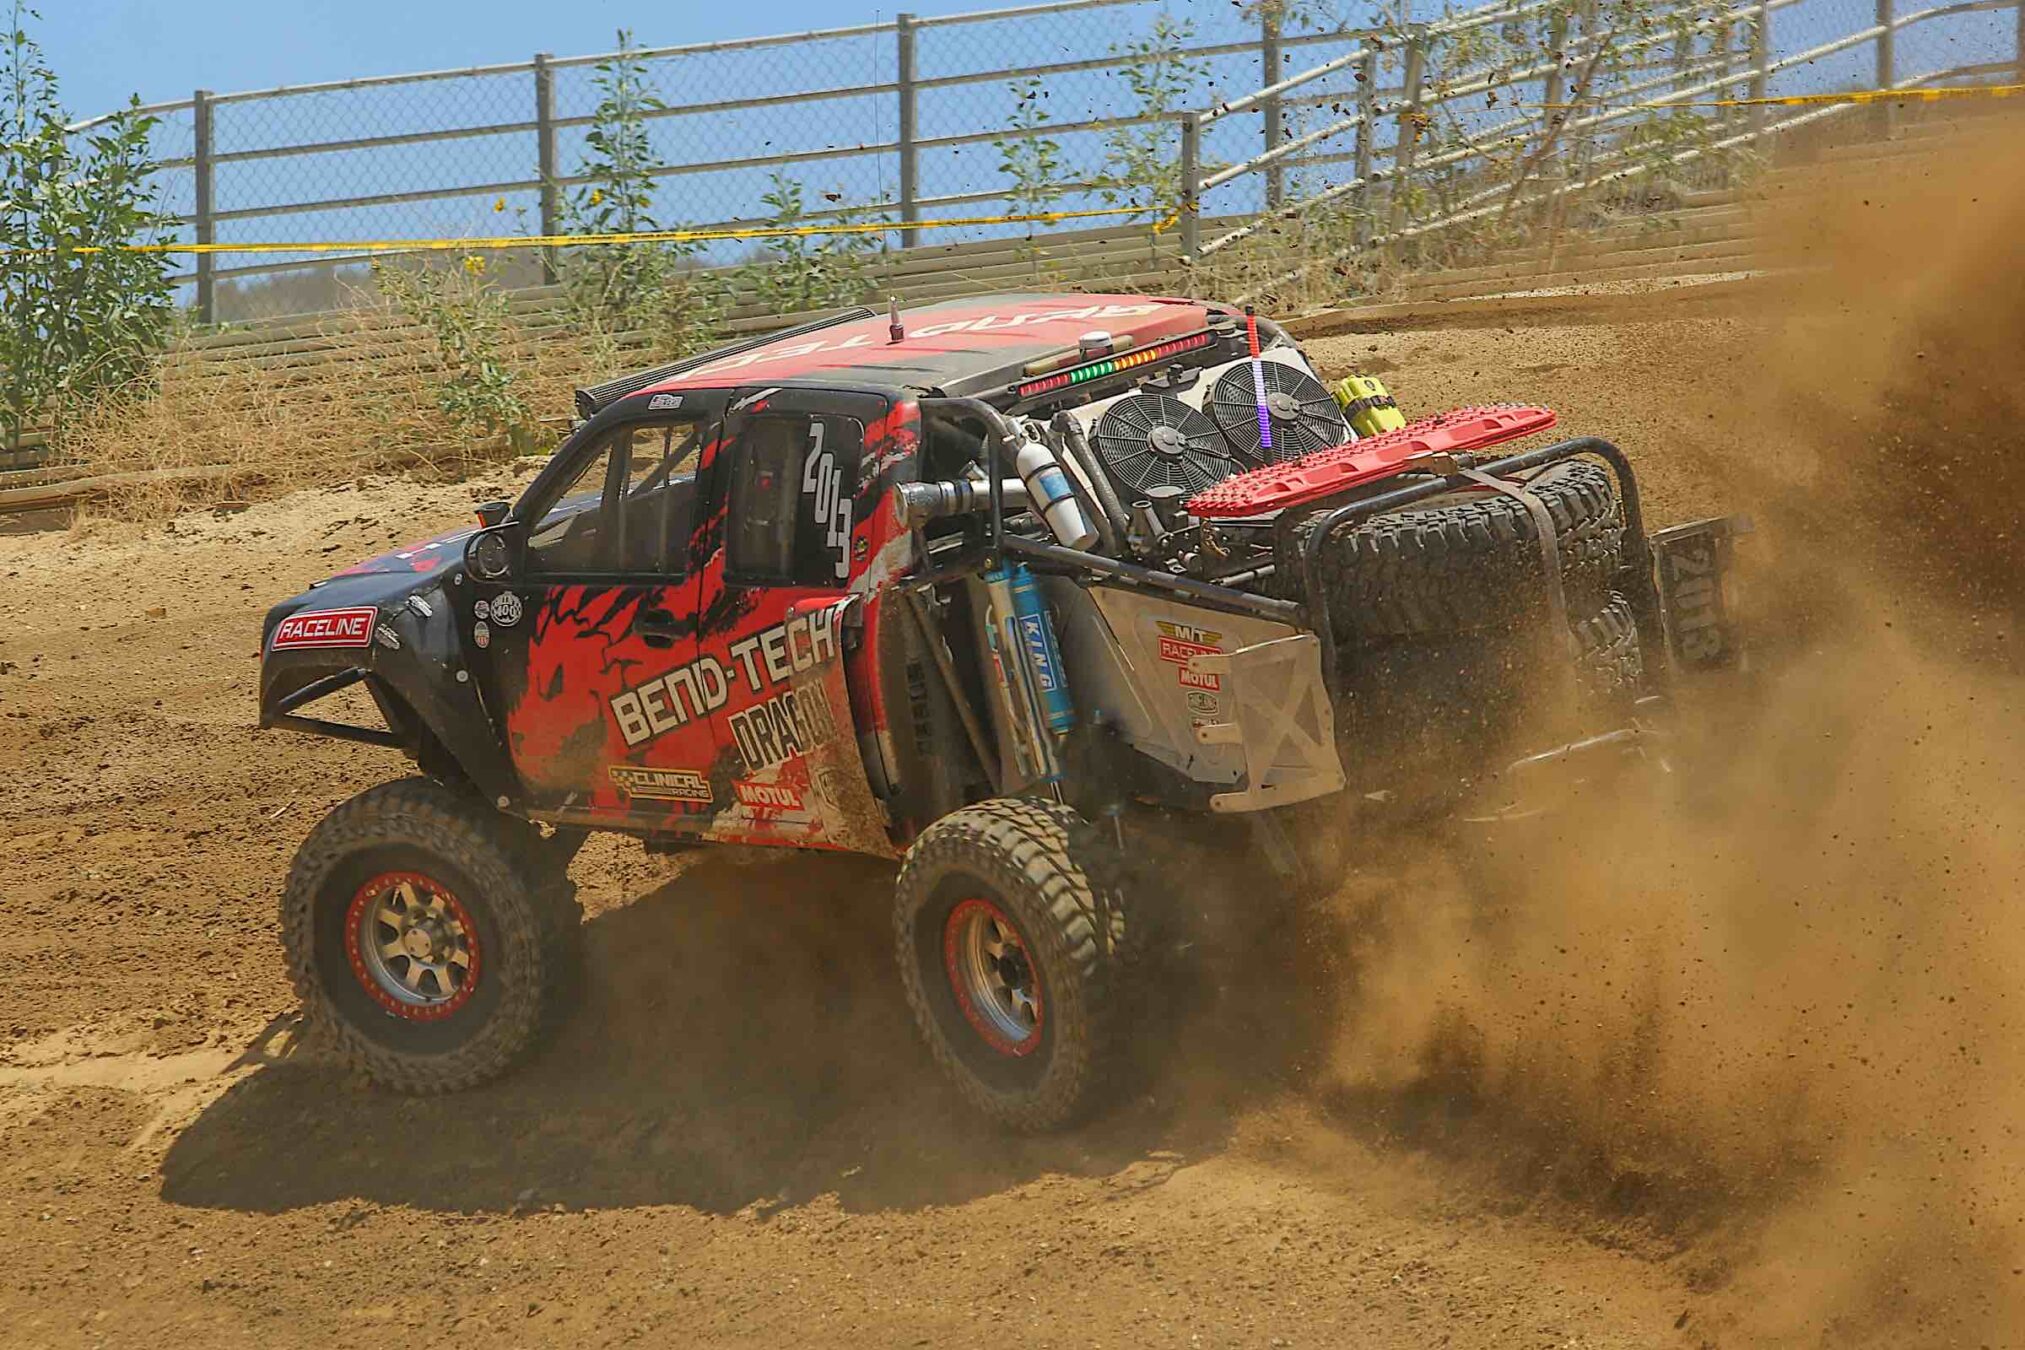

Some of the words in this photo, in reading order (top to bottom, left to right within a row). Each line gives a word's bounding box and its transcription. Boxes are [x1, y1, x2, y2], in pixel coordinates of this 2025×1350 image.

[802, 422, 852, 579] 2013
[278, 616, 366, 639] RACELINE
[1174, 625, 1207, 643] M/T
[1023, 620, 1054, 689] KING
[610, 607, 836, 746] BEND-TECH
[1180, 669, 1218, 688] MOTUL
[632, 772, 707, 789] CLINICAL
[671, 788, 710, 798] RACING
[740, 784, 801, 807] MOTUL
